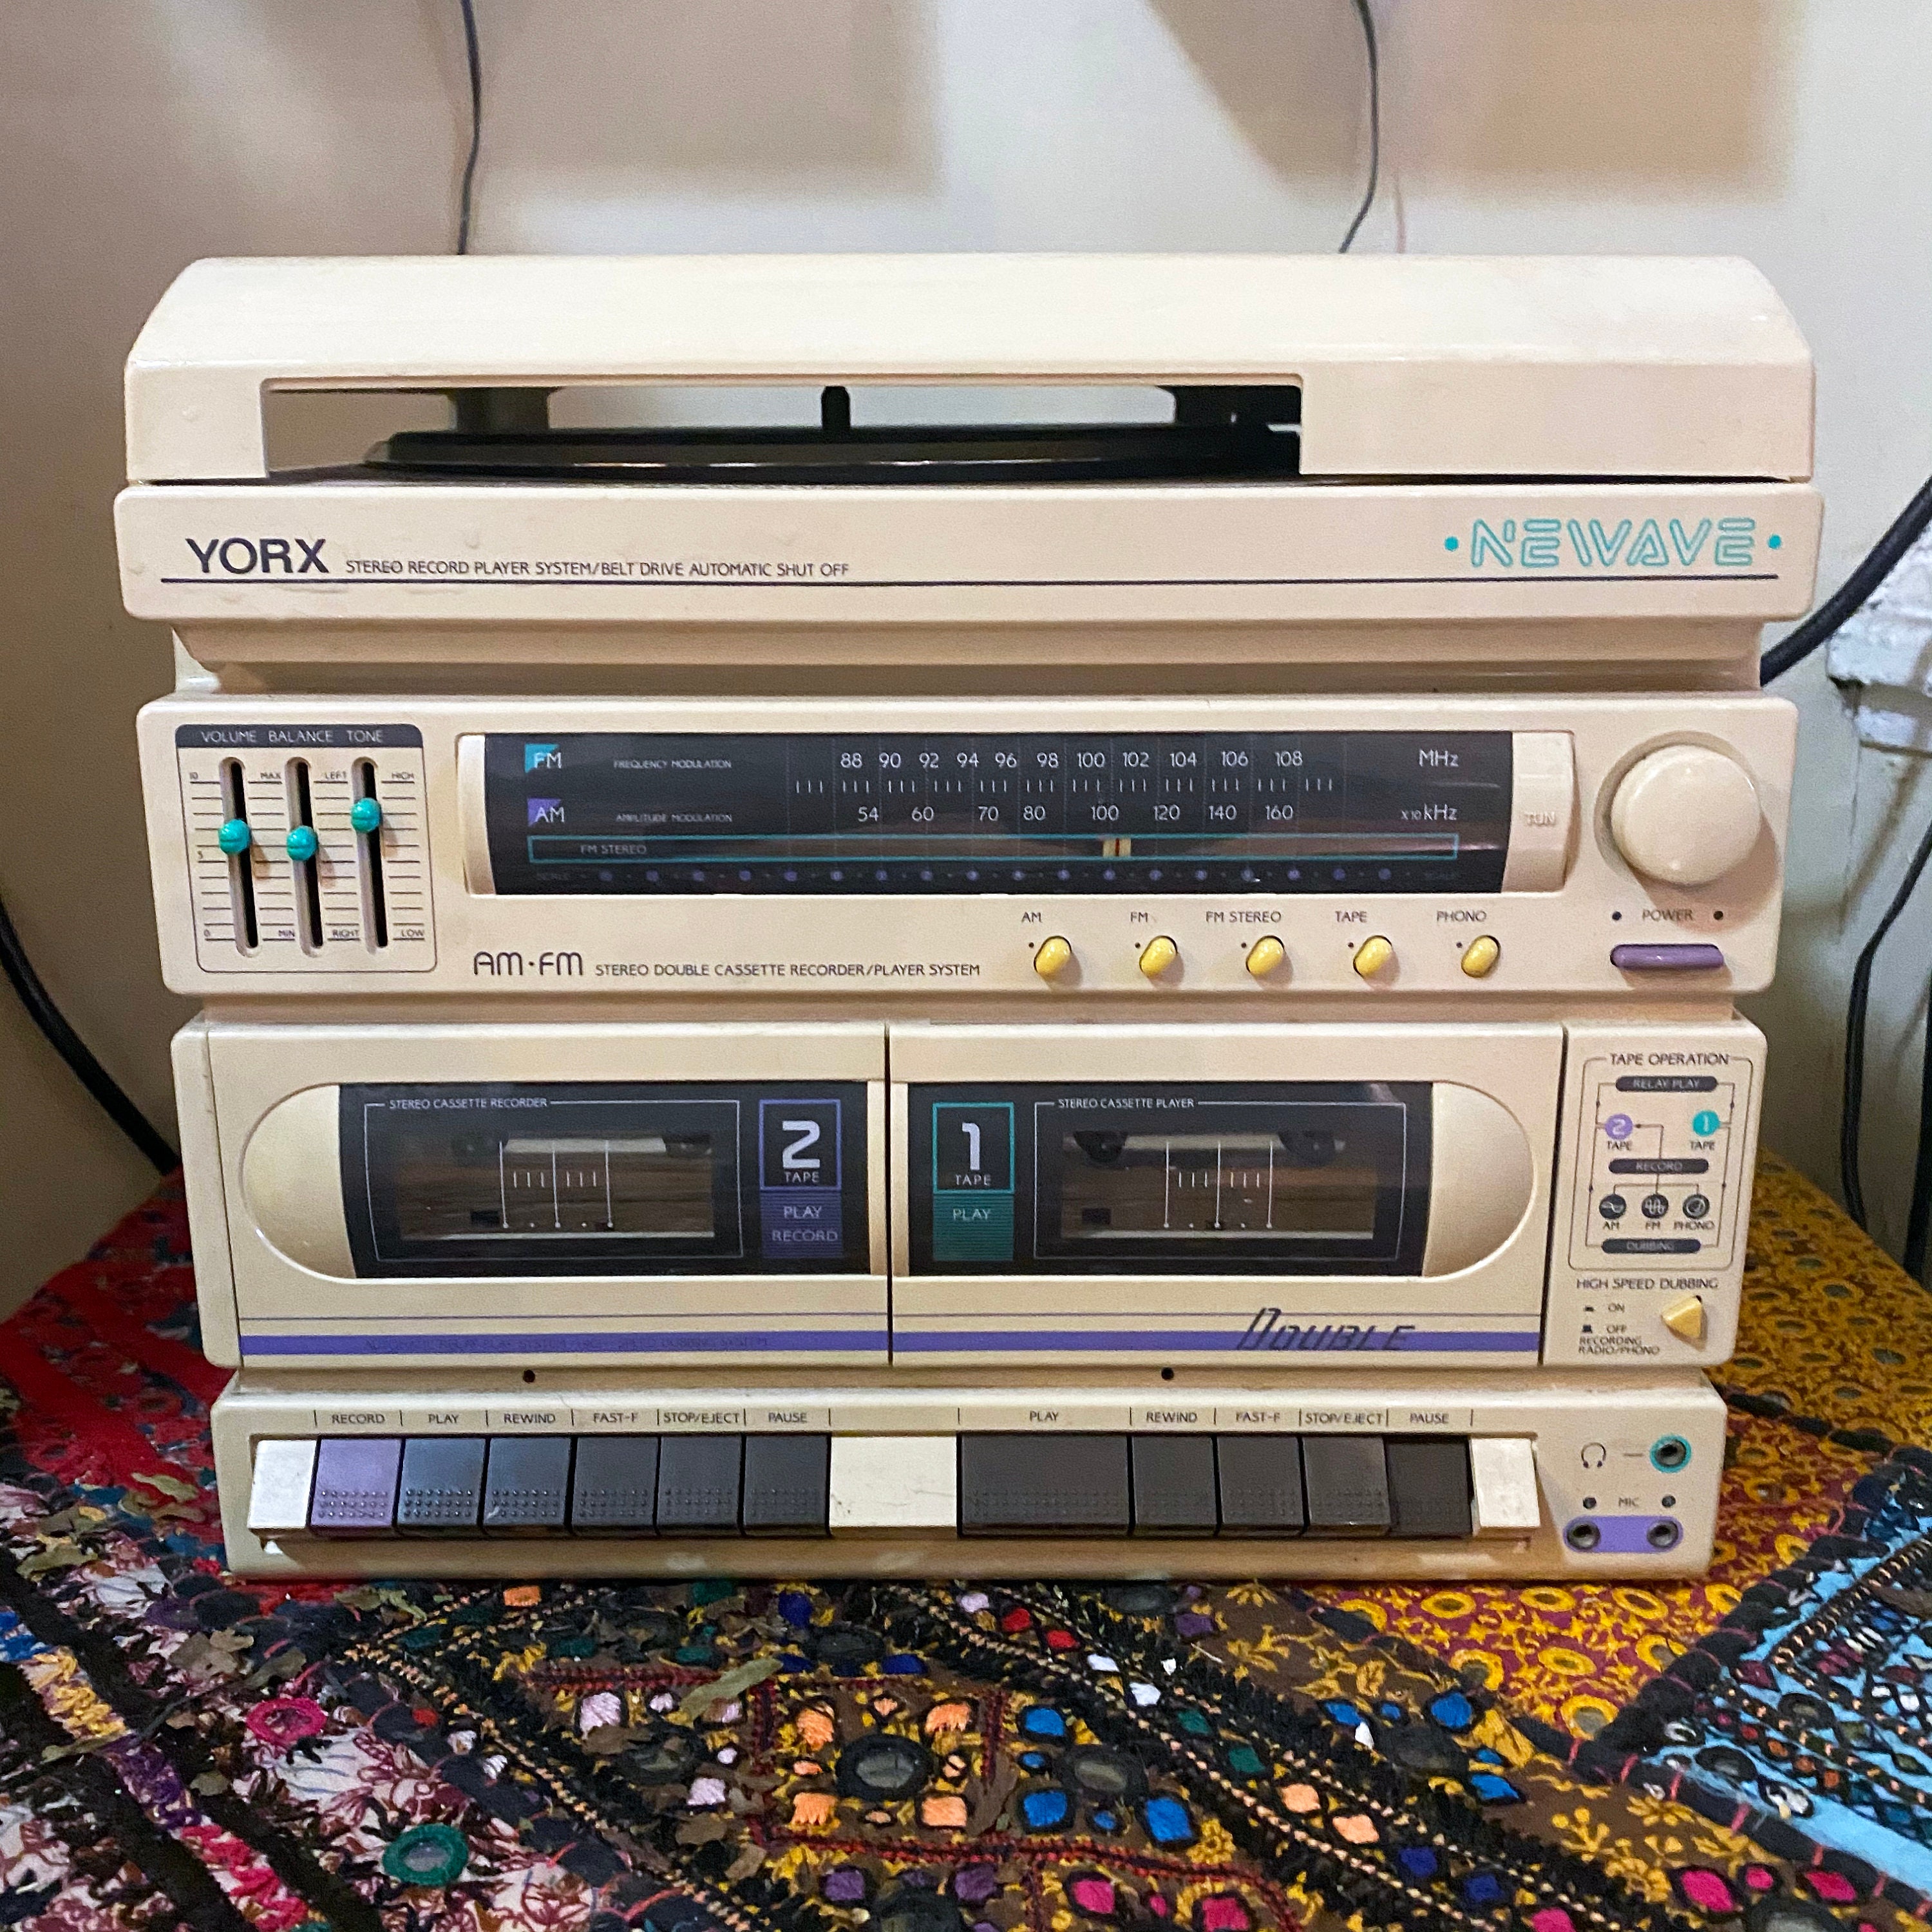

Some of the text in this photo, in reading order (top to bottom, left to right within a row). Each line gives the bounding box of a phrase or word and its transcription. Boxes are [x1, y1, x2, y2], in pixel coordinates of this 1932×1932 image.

[1471, 517, 1756, 568] NEWAVE
[185, 538, 329, 574] YORX
[346, 560, 849, 577] STEREO RECORD PLAYER SYSTEM/BELT DRIVE AUTOMATIC SHUT OFF
[201, 730, 383, 743] VOLUME BALANCE TONE
[534, 752, 562, 768] FM
[672, 760, 732, 768] MODULATION
[840, 750, 1459, 768] 88 90 92 94 96 98 100 102 104 106 108 MHz
[325, 772, 346, 780] LEFT
[534, 807, 565, 823] AM
[858, 806, 878, 822] 54
[912, 806, 934, 822] 60
[978, 806, 999, 822] 70
[1023, 806, 1046, 821] 80
[1092, 806, 1119, 821] 100
[1153, 806, 1180, 821] 120
[1209, 806, 1237, 820] 140
[1266, 805, 1294, 820] 160
[1526, 811, 1556, 826] TUN
[581, 844, 647, 855] FM STEREO
[1022, 911, 1041, 923] AM
[1130, 911, 1149, 923] FM
[1206, 911, 1282, 923] FM STEREO
[1335, 911, 1367, 923] TAPE
[1437, 911, 1487, 923] PHONO
[1642, 909, 1694, 921] POWER
[332, 929, 360, 938] RIGHT
[596, 964, 980, 976] STEREO DOUBLE CASSETTE RECORDER/PLAYER SYSTEM
[1610, 1052, 1729, 1066] TAPE OPERATION
[389, 1097, 548, 1110] STEREO CASSETTE RECORDER
[1058, 1098, 1194, 1109] STEREO CASSETTE PLAYER
[1612, 1119, 1626, 1135] 2
[1702, 1114, 1709, 1132] 1
[782, 1121, 820, 1168] 2
[962, 1122, 980, 1171] 1
[1607, 1140, 1632, 1151] TAPE
[1690, 1140, 1716, 1150] TAPE
[784, 1171, 820, 1183] TAPE
[955, 1174, 992, 1186] TAPE
[783, 1206, 822, 1219] PLAY
[952, 1208, 992, 1221] PLAY
[772, 1229, 838, 1242] RECORD
[1577, 1278, 1718, 1289] HIGH SPEED DUBBING
[1608, 1302, 1625, 1313] ON
[1606, 1324, 1627, 1334] OFF
[332, 1414, 386, 1424] RECORD
[428, 1414, 460, 1424] PLAY
[504, 1413, 556, 1424] REWIND
[663, 1412, 741, 1425] STOP/EJECT
[768, 1412, 808, 1423] PAUSE
[1030, 1411, 1059, 1422] PLAY
[1146, 1411, 1198, 1423] REWIND
[1236, 1412, 1280, 1423] FAST-F
[1409, 1412, 1449, 1424] PAUSE
